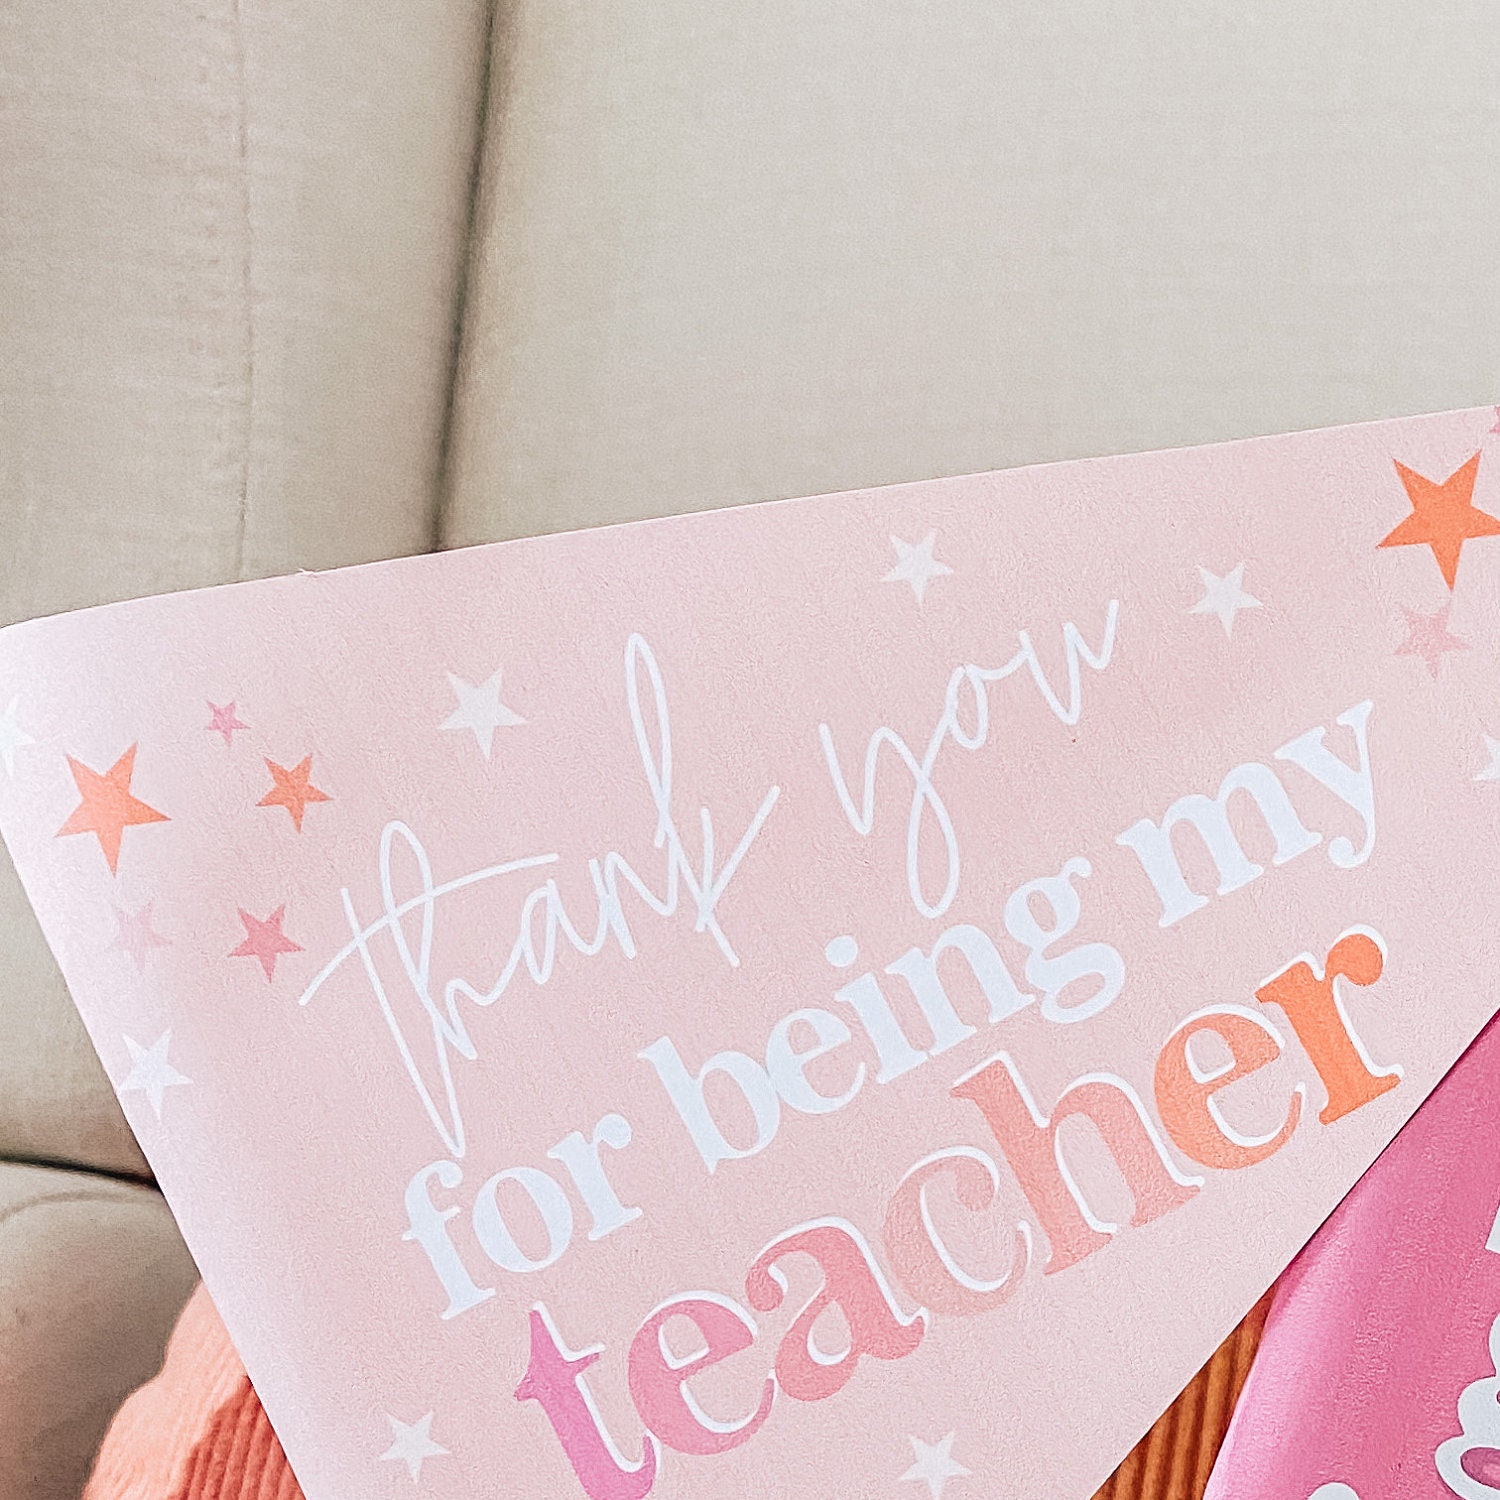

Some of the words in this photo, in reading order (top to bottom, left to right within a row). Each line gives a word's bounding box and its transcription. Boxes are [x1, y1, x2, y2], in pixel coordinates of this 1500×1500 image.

[298, 632, 781, 1157] thank
[817, 600, 1121, 918] you
[400, 1112, 644, 1322] for
[637, 855, 1128, 1175] being
[1115, 698, 1377, 930] my
